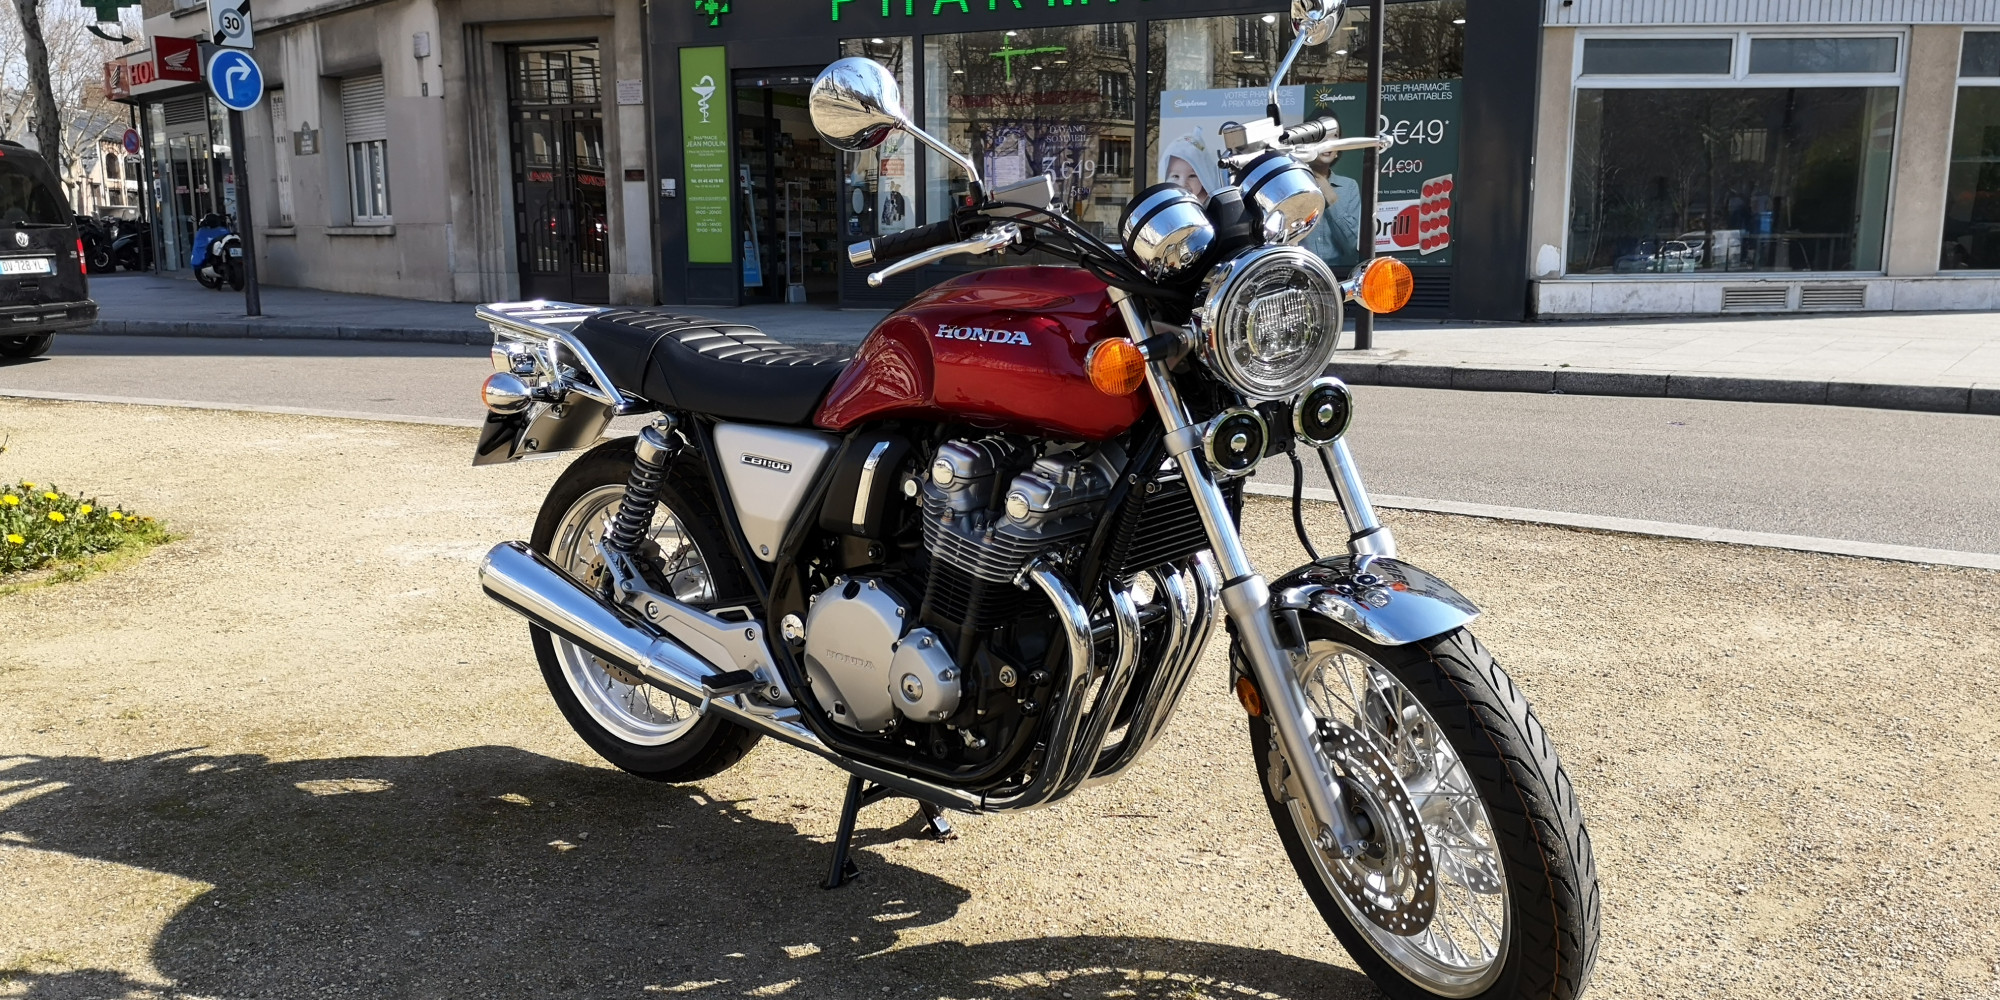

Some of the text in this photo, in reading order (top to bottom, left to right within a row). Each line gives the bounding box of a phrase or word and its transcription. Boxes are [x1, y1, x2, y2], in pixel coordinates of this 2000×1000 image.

[224, 16, 240, 30] 30
[1380, 83, 1451, 93] OTRE PHARMACIE
[1319, 93, 1356, 103] Sunipharma
[1398, 91, 1453, 101] IMBATTABLES
[1049, 125, 1086, 133] DAYANG
[1381, 157, 1423, 178] 4€90
[935, 324, 1031, 346] HONDA
[826, 648, 876, 670] HONDA
